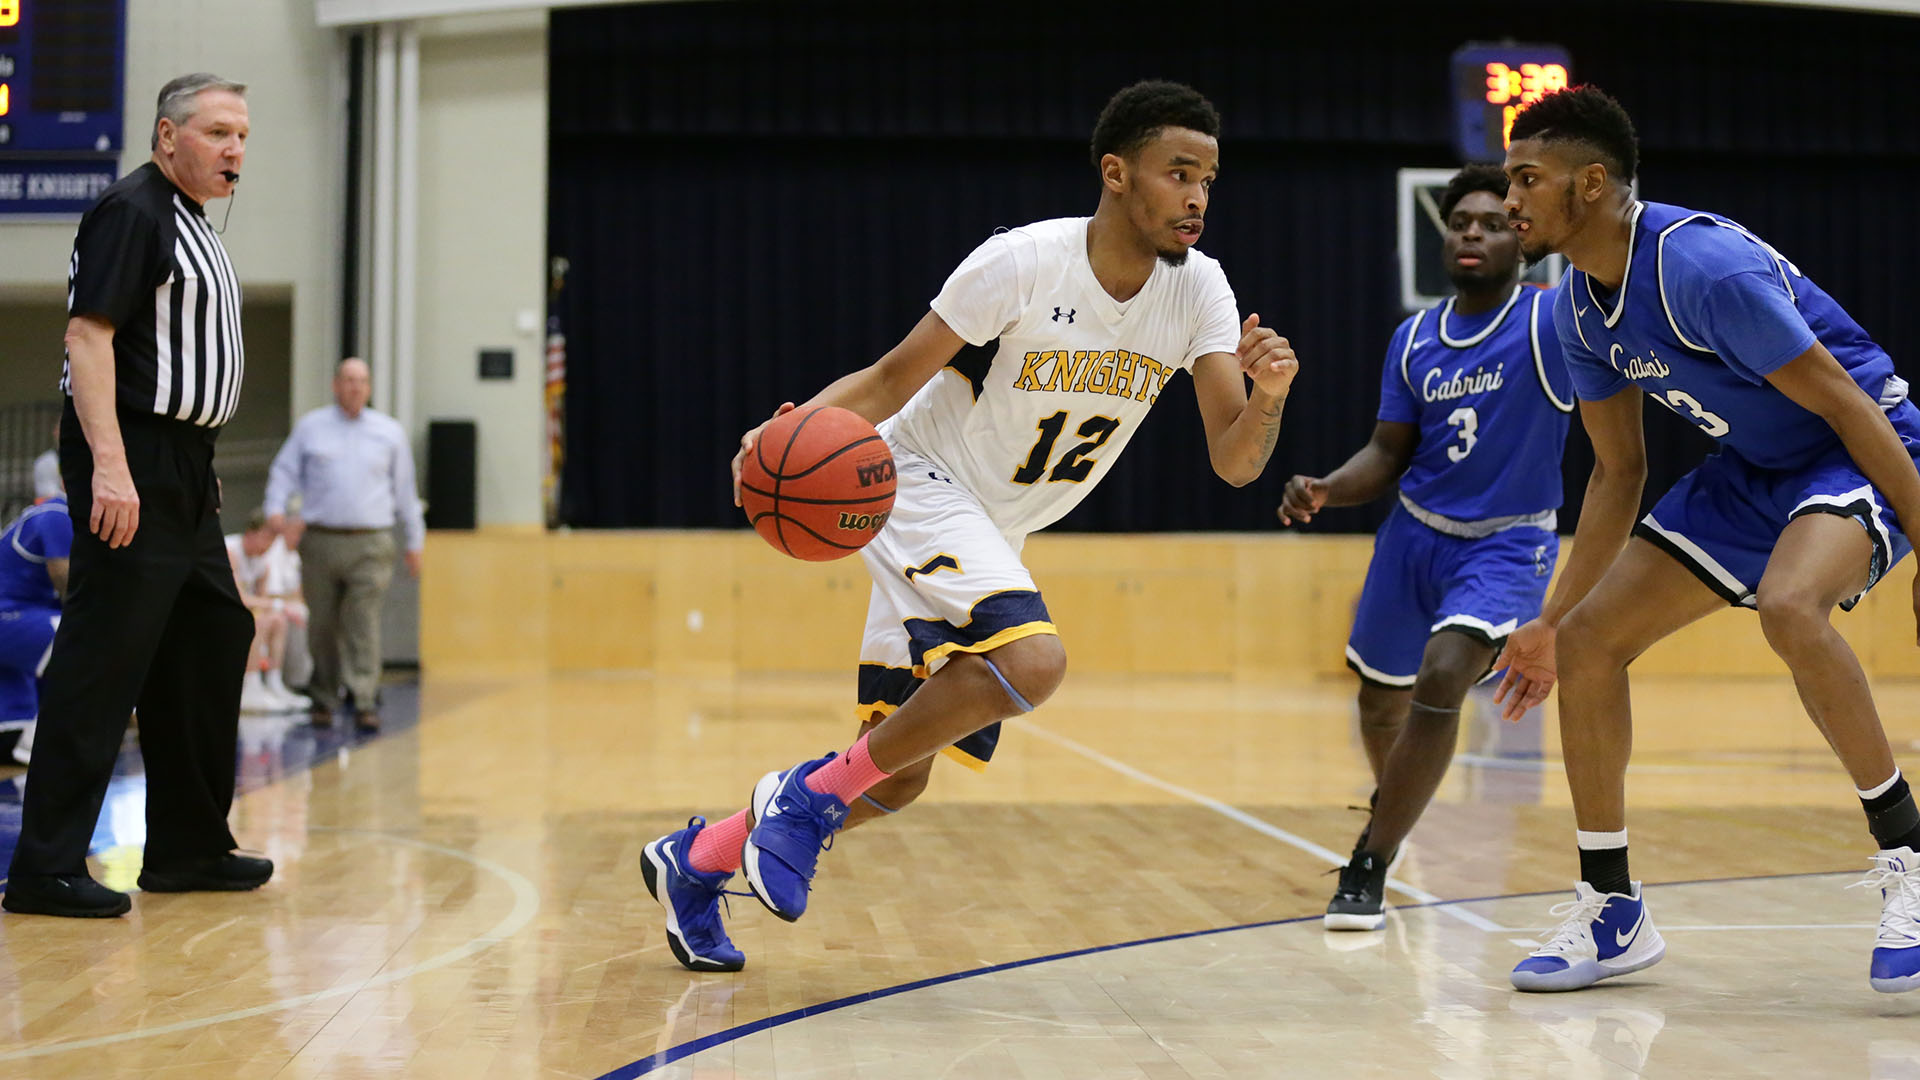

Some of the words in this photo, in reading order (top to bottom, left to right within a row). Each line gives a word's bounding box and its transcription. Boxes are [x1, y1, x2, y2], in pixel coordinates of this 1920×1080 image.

[1423, 362, 1504, 402] Cabrini
[1447, 407, 1478, 464] 3
[1649, 390, 1730, 437] 3
[1010, 409, 1122, 486] 12
